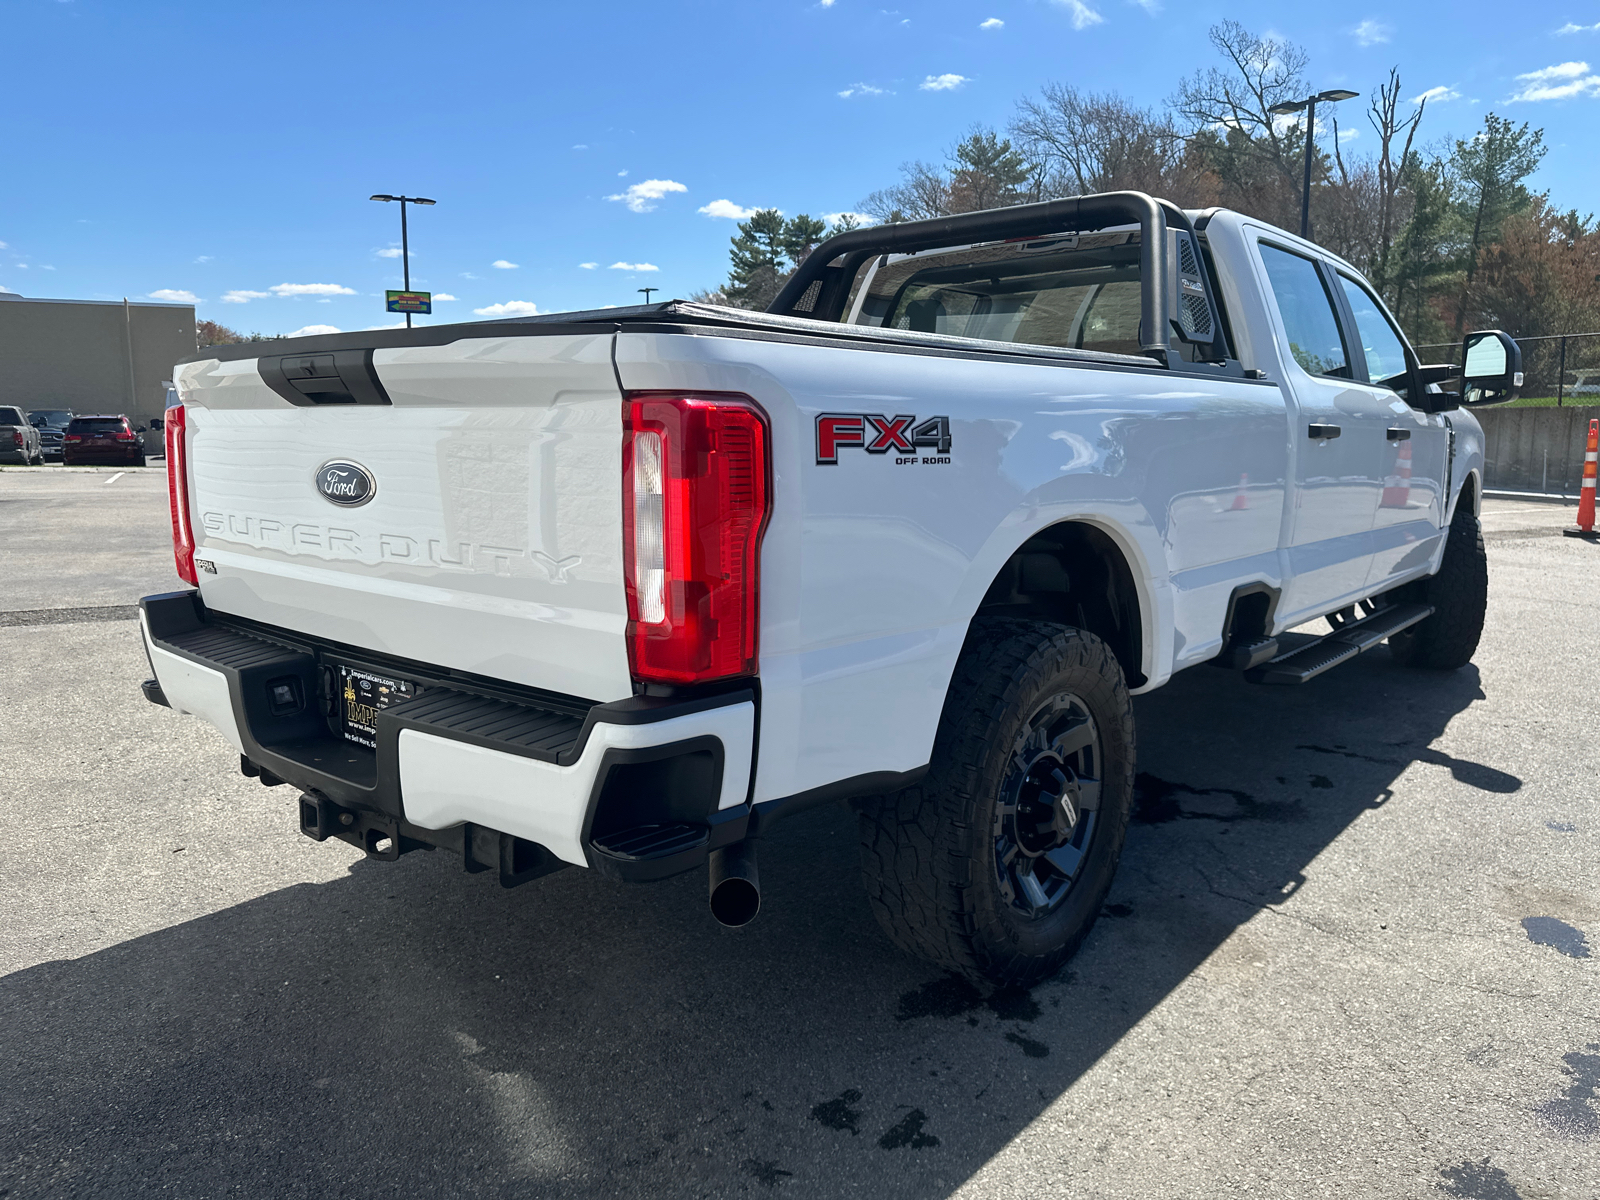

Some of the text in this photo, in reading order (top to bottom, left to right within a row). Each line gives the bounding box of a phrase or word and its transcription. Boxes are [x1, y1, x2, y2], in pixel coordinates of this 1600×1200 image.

[815, 412, 952, 466] FX4
[895, 457, 951, 465] OFF ROAD
[324, 468, 357, 498] Ford
[202, 511, 582, 584] SUPER DUTY
